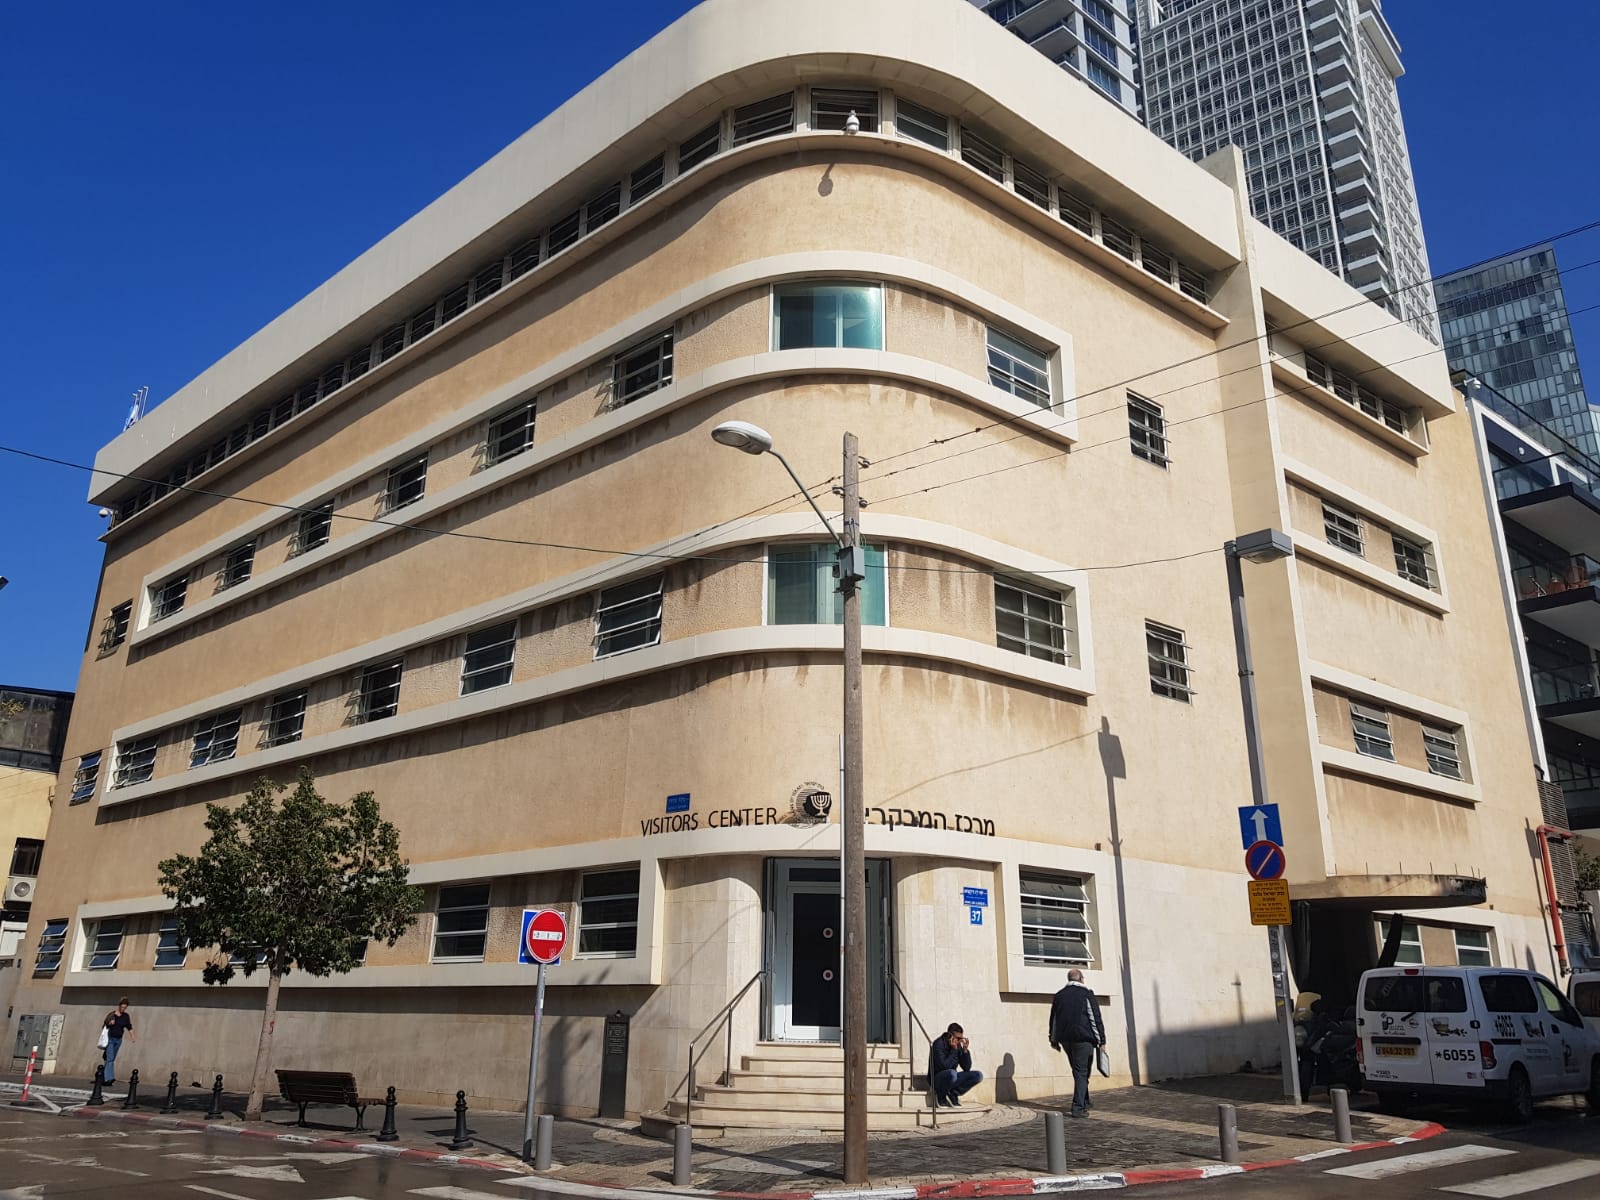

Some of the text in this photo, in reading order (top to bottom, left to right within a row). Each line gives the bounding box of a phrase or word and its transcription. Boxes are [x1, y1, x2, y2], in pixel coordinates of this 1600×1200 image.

[640, 807, 777, 837] VISITORS CENTER
[865, 807, 996, 836] מרכז המבקרי
[971, 910, 981, 922] 37
